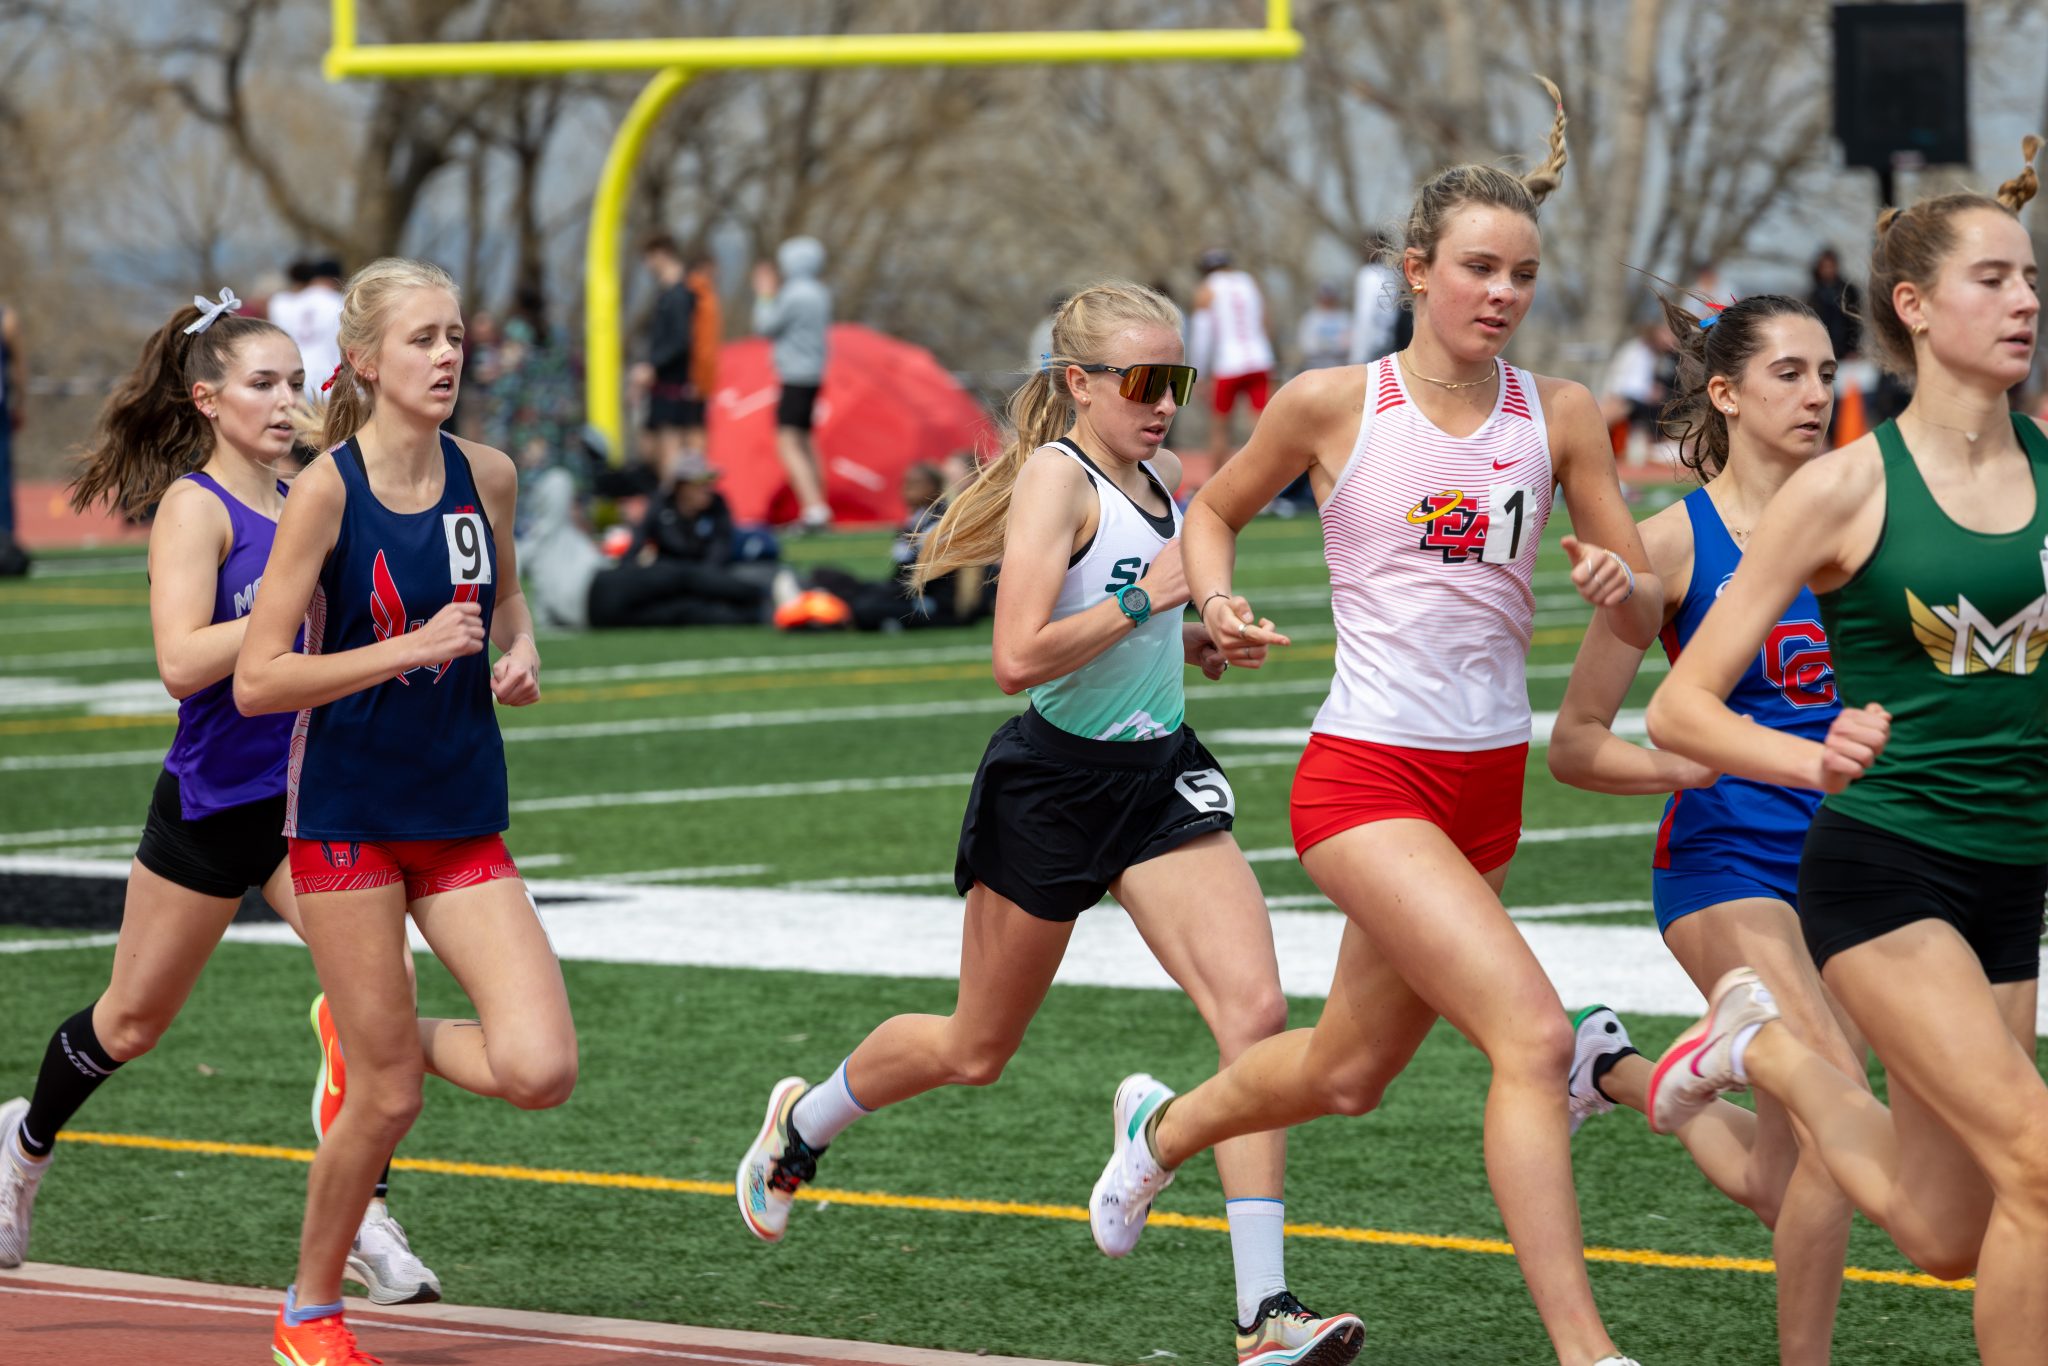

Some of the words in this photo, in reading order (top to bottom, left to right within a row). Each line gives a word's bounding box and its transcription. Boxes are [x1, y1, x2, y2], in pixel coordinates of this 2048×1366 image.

[455, 517, 482, 580] 9
[1504, 490, 1524, 559] 1
[1181, 773, 1228, 809] 5
